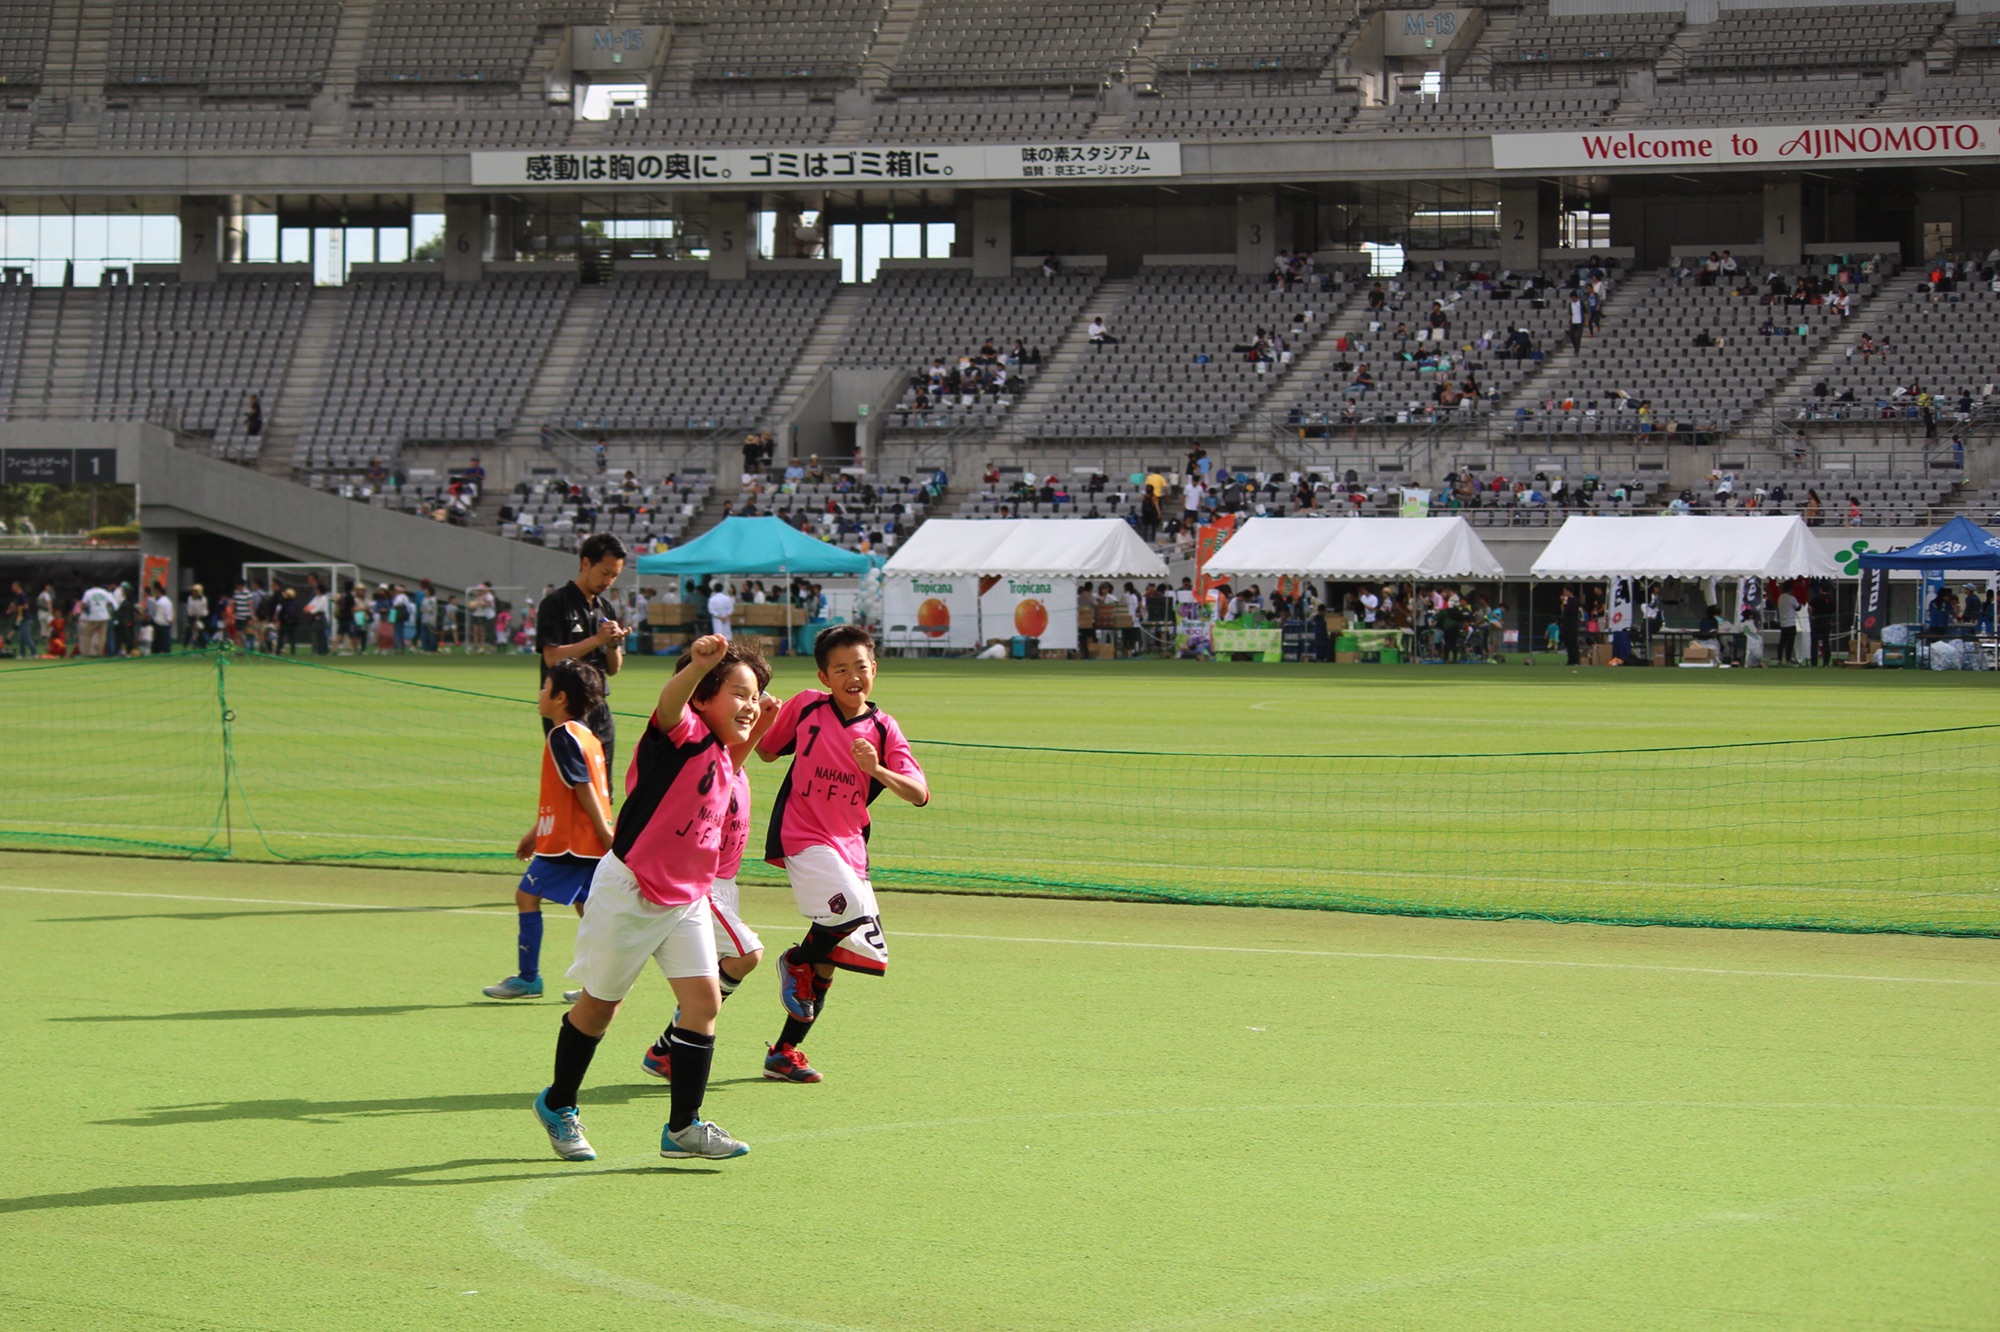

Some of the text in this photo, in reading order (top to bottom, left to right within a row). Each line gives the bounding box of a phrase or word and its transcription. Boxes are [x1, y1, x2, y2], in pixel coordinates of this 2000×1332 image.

[1404, 12, 1455, 35] M-13
[592, 28, 644, 50] M-15
[1582, 124, 1980, 159] Welcome to AJINOMOTO
[1021, 145, 1150, 163] 味の素スタジアム
[525, 150, 954, 181] 感動は胸の奥に。 ゴミはゴミ箱に。
[1250, 224, 1262, 245] 3
[1513, 219, 1525, 240] 2
[1776, 214, 1785, 235] 1
[193, 233, 205, 254] 7
[457, 233, 470, 253] 6
[721, 231, 733, 251] 5
[90, 457, 100, 475] 1
[911, 579, 953, 595] Tropicana
[1008, 579, 1052, 595] Tropicana
[802, 725, 821, 757] 7
[698, 760, 717, 796] 8
[815, 766, 856, 786] NAKANO
